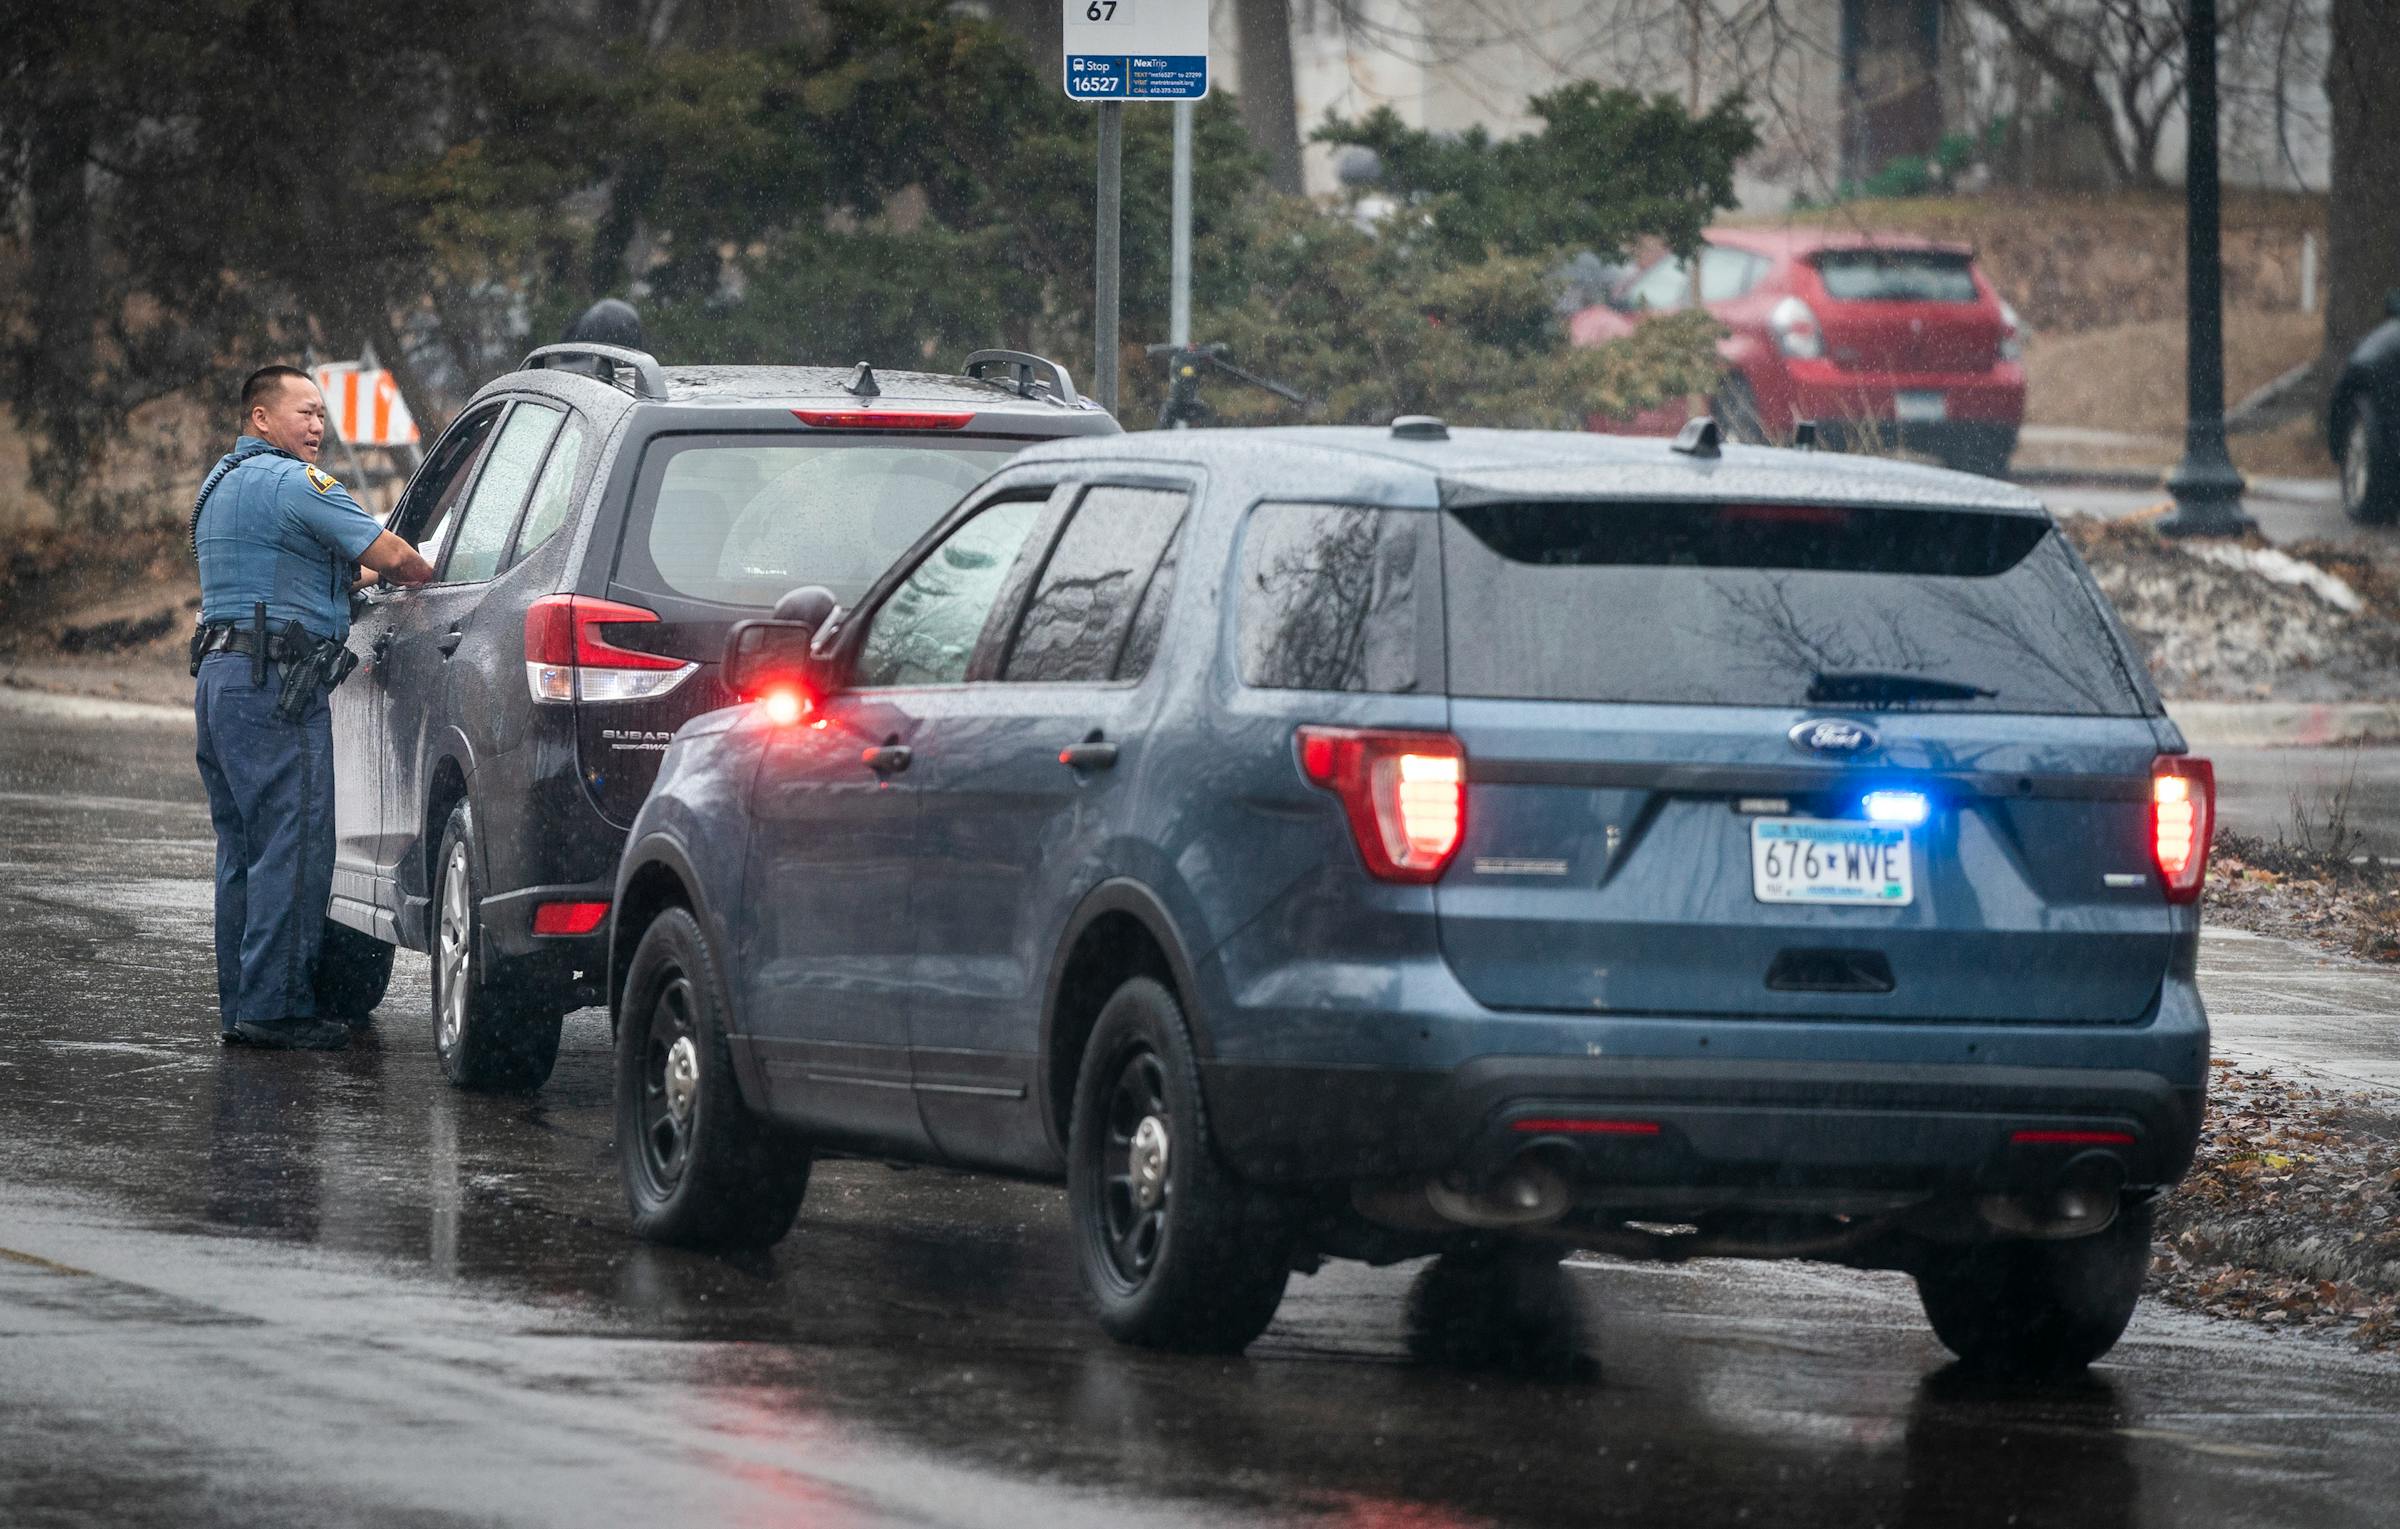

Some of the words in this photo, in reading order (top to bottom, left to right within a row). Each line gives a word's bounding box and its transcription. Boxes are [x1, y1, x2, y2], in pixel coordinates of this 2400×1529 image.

[1086, 1, 1117, 21] 67
[1087, 61, 1110, 73] Stop
[1133, 59, 1168, 70] NexTrip
[1073, 77, 1119, 92] 16527
[602, 730, 675, 740] SUBAR
[1811, 724, 1862, 750] Ford
[1766, 841, 1820, 879] 676
[1845, 843, 1901, 882] WVE
